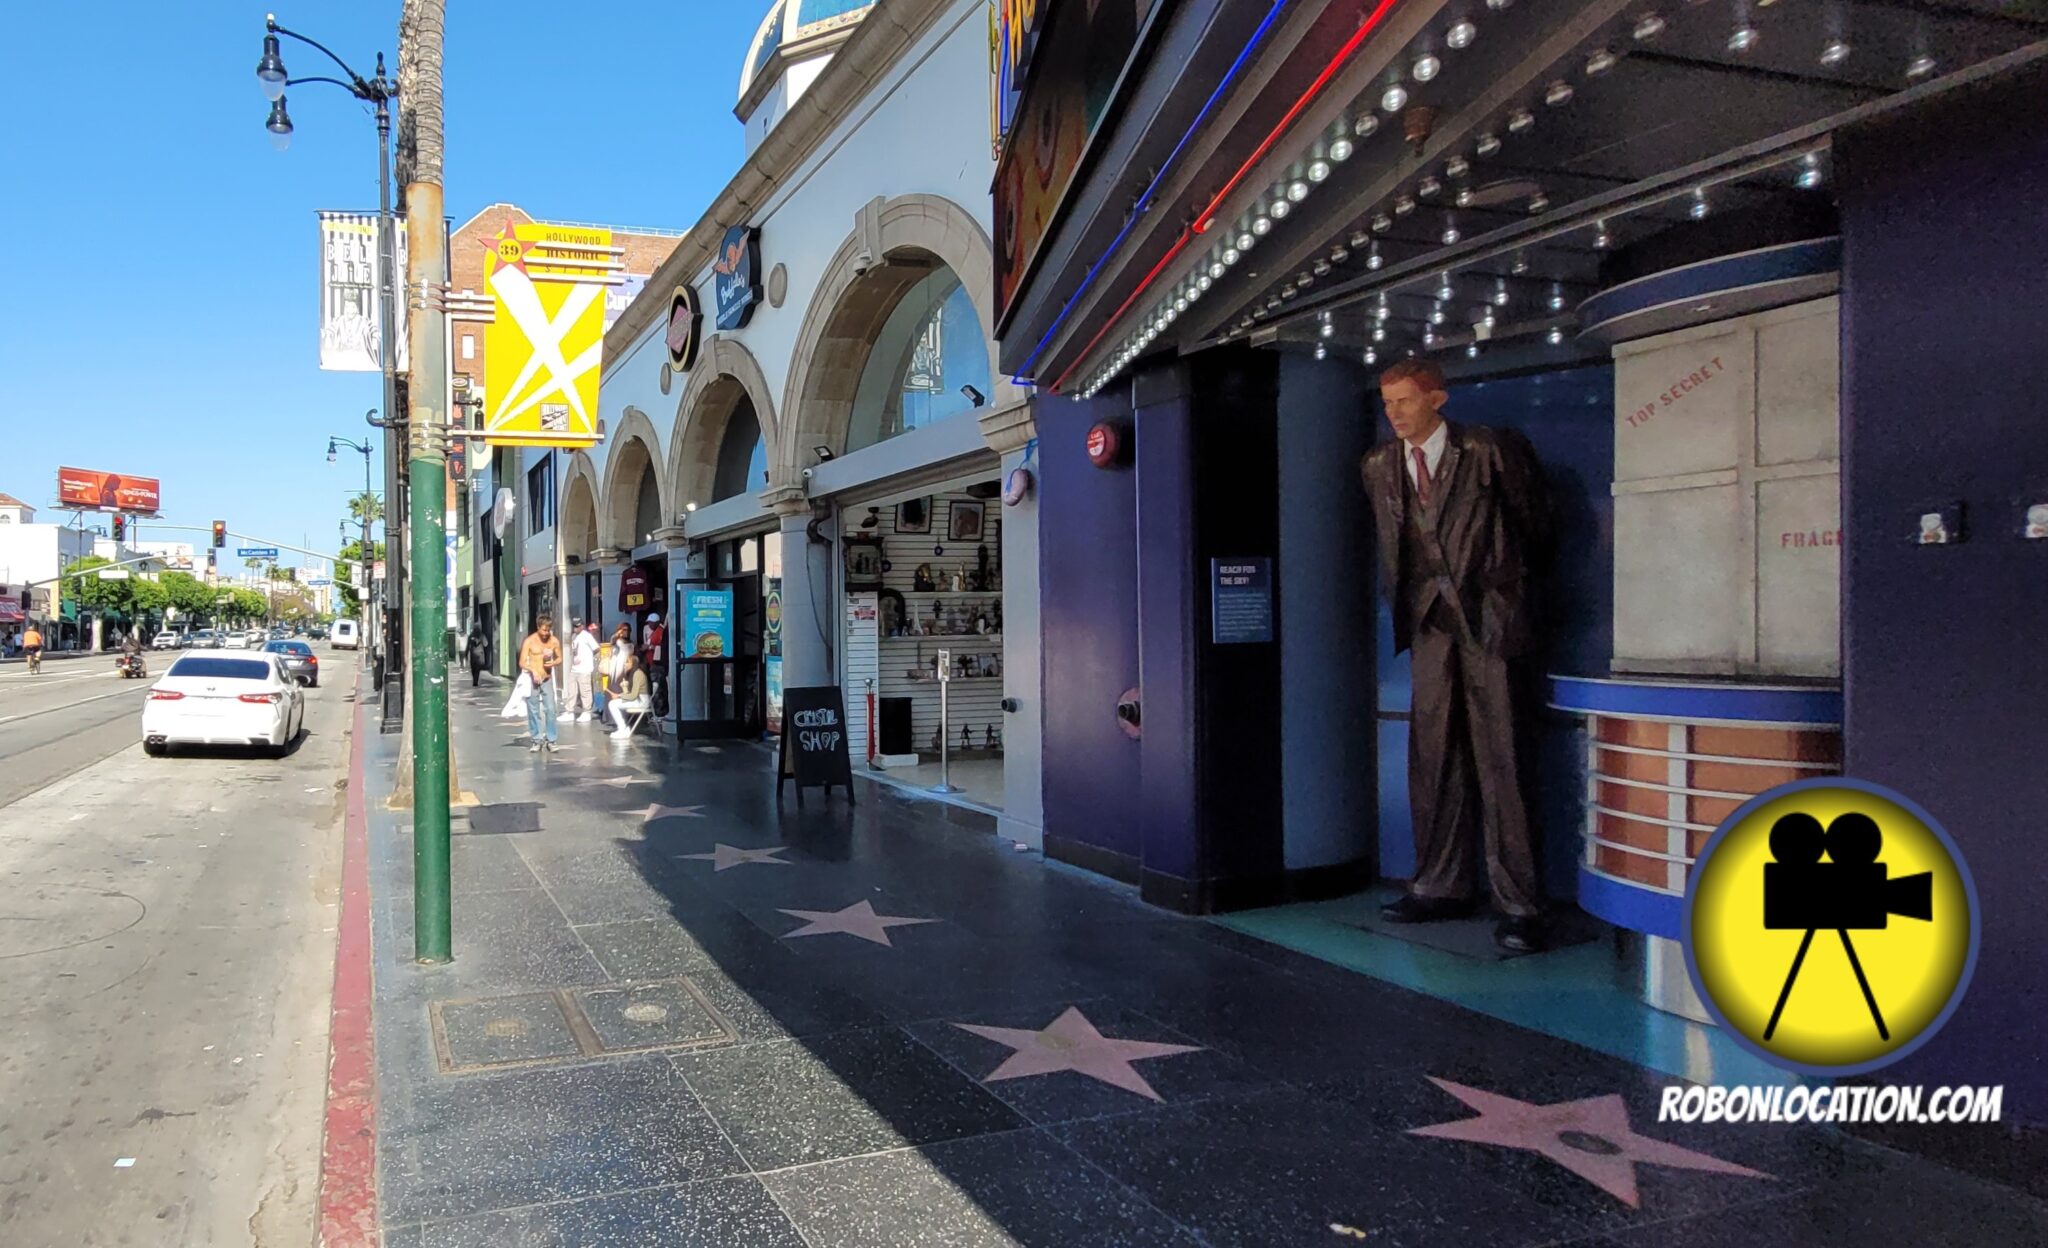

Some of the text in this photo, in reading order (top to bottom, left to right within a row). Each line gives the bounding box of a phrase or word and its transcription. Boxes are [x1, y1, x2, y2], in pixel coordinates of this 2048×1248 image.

[546, 233, 601, 245] HOLLYWOOD
[500, 244, 519, 256] 39
[546, 248, 600, 260] HISTORIC
[1626, 357, 1723, 427] TOP SECRET
[1220, 565, 1256, 574] REACH FOR
[1220, 577, 1233, 585] THE
[696, 596, 723, 604] FRESH
[799, 730, 841, 752] SHOP
